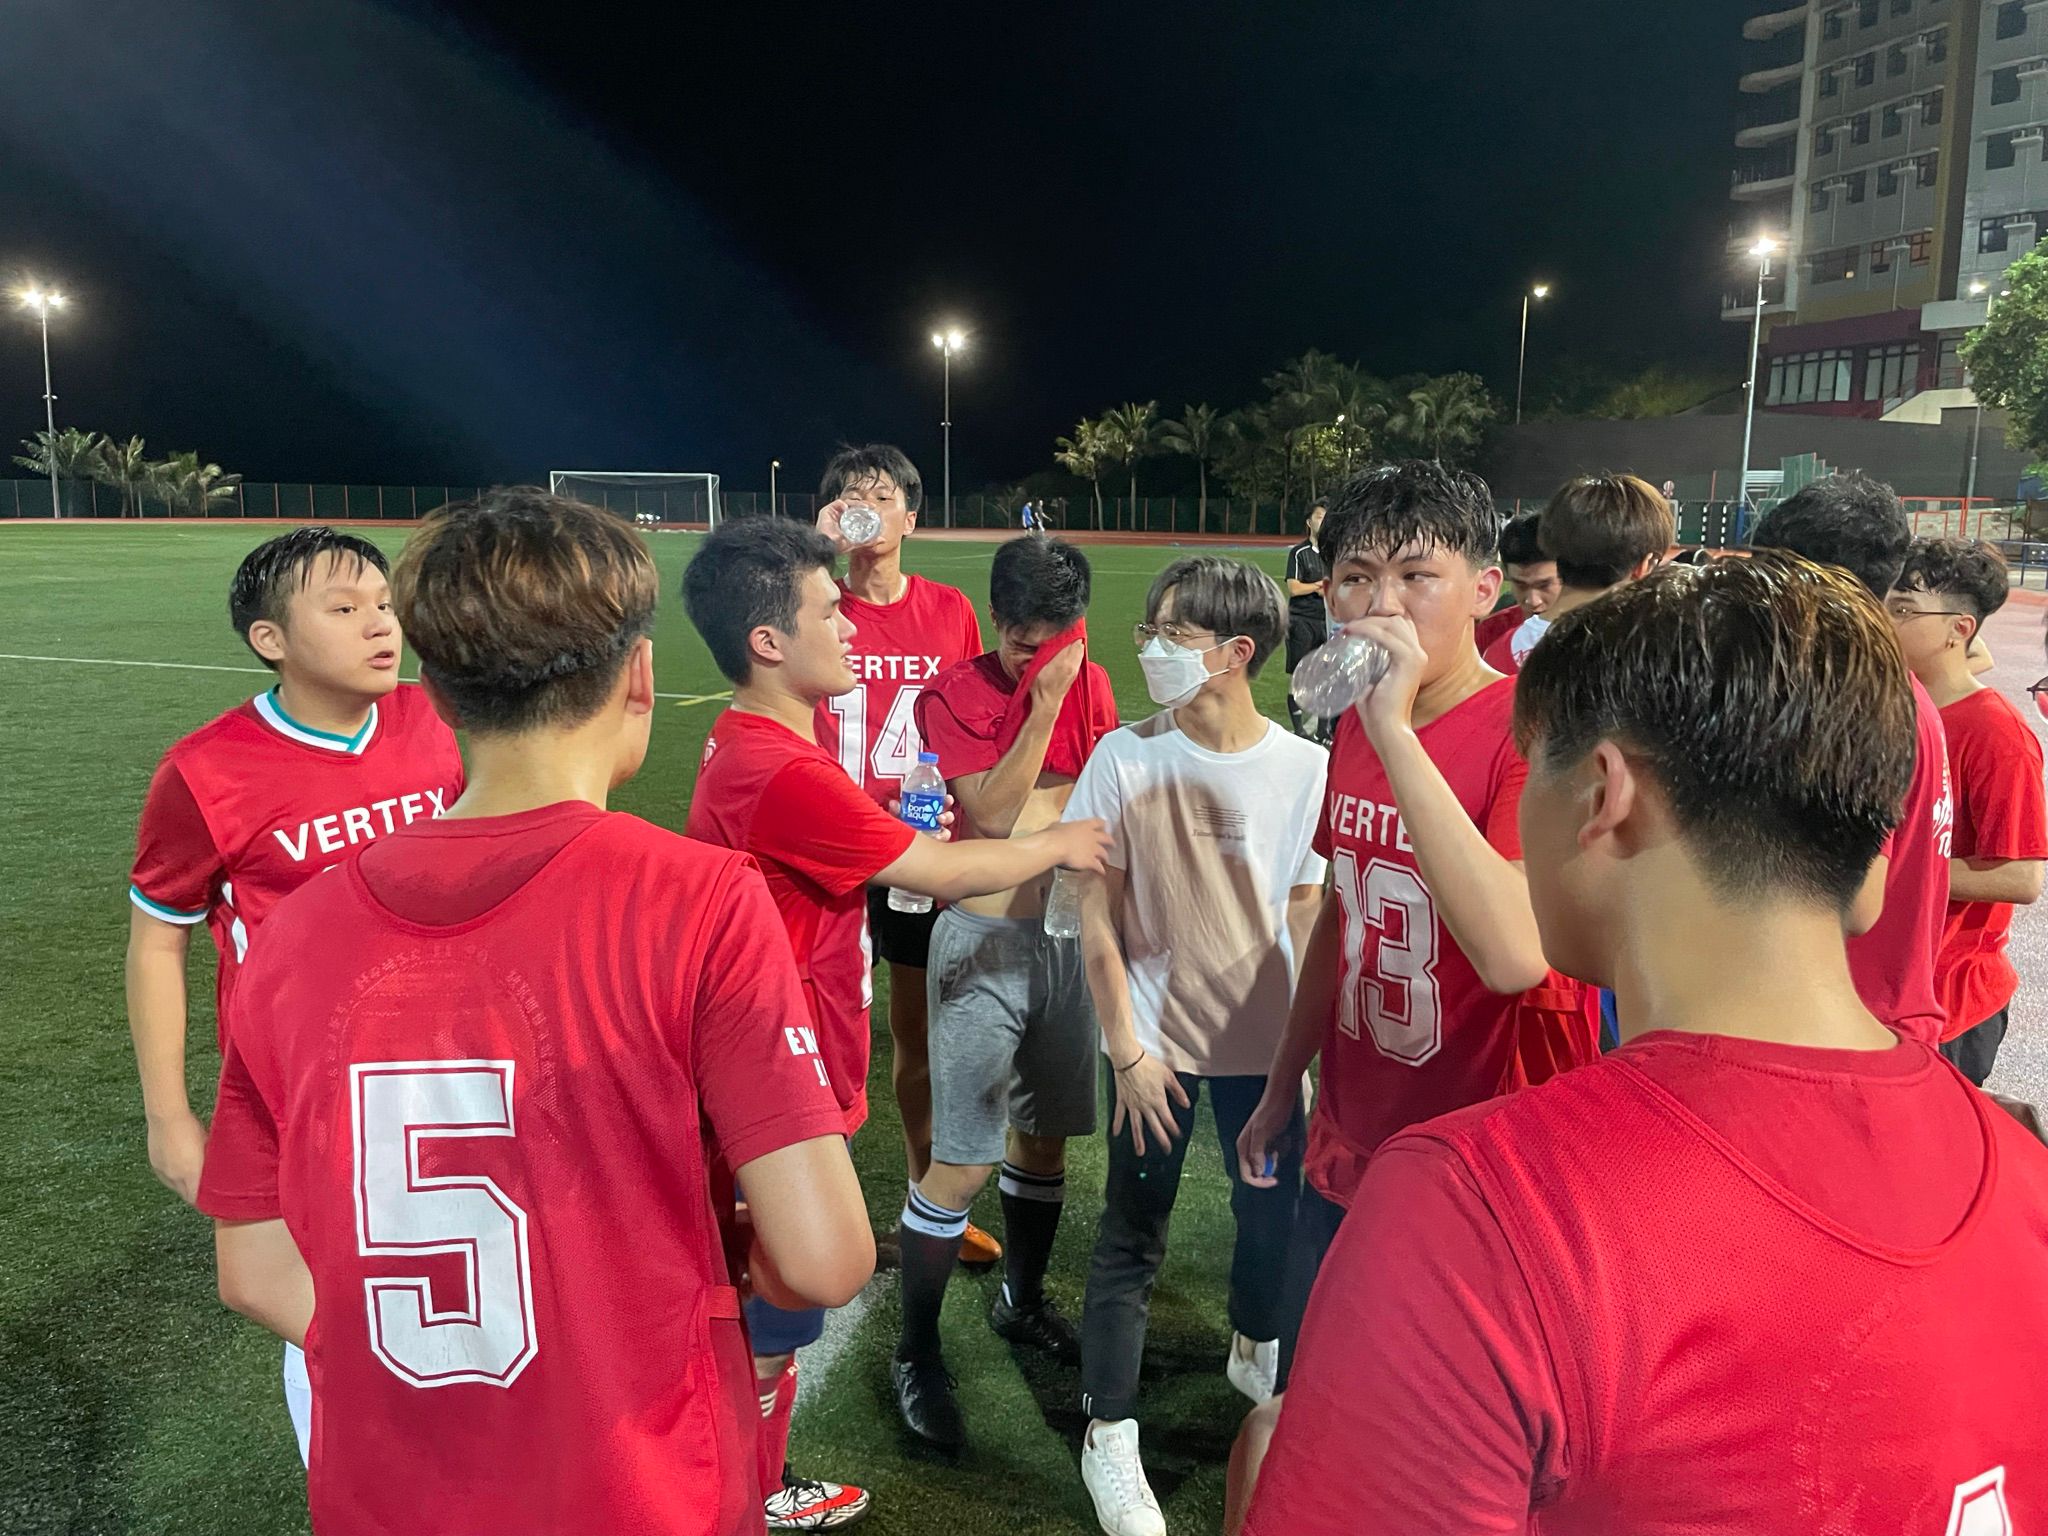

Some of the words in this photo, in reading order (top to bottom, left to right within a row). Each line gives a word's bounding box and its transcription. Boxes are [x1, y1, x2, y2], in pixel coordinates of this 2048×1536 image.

[850, 654, 941, 680] ERTEX
[828, 683, 925, 798] 14
[272, 787, 446, 862] VERTEX
[1330, 790, 1414, 853] VERTE
[1333, 846, 1442, 1067] 13
[349, 1059, 539, 1389] 5
